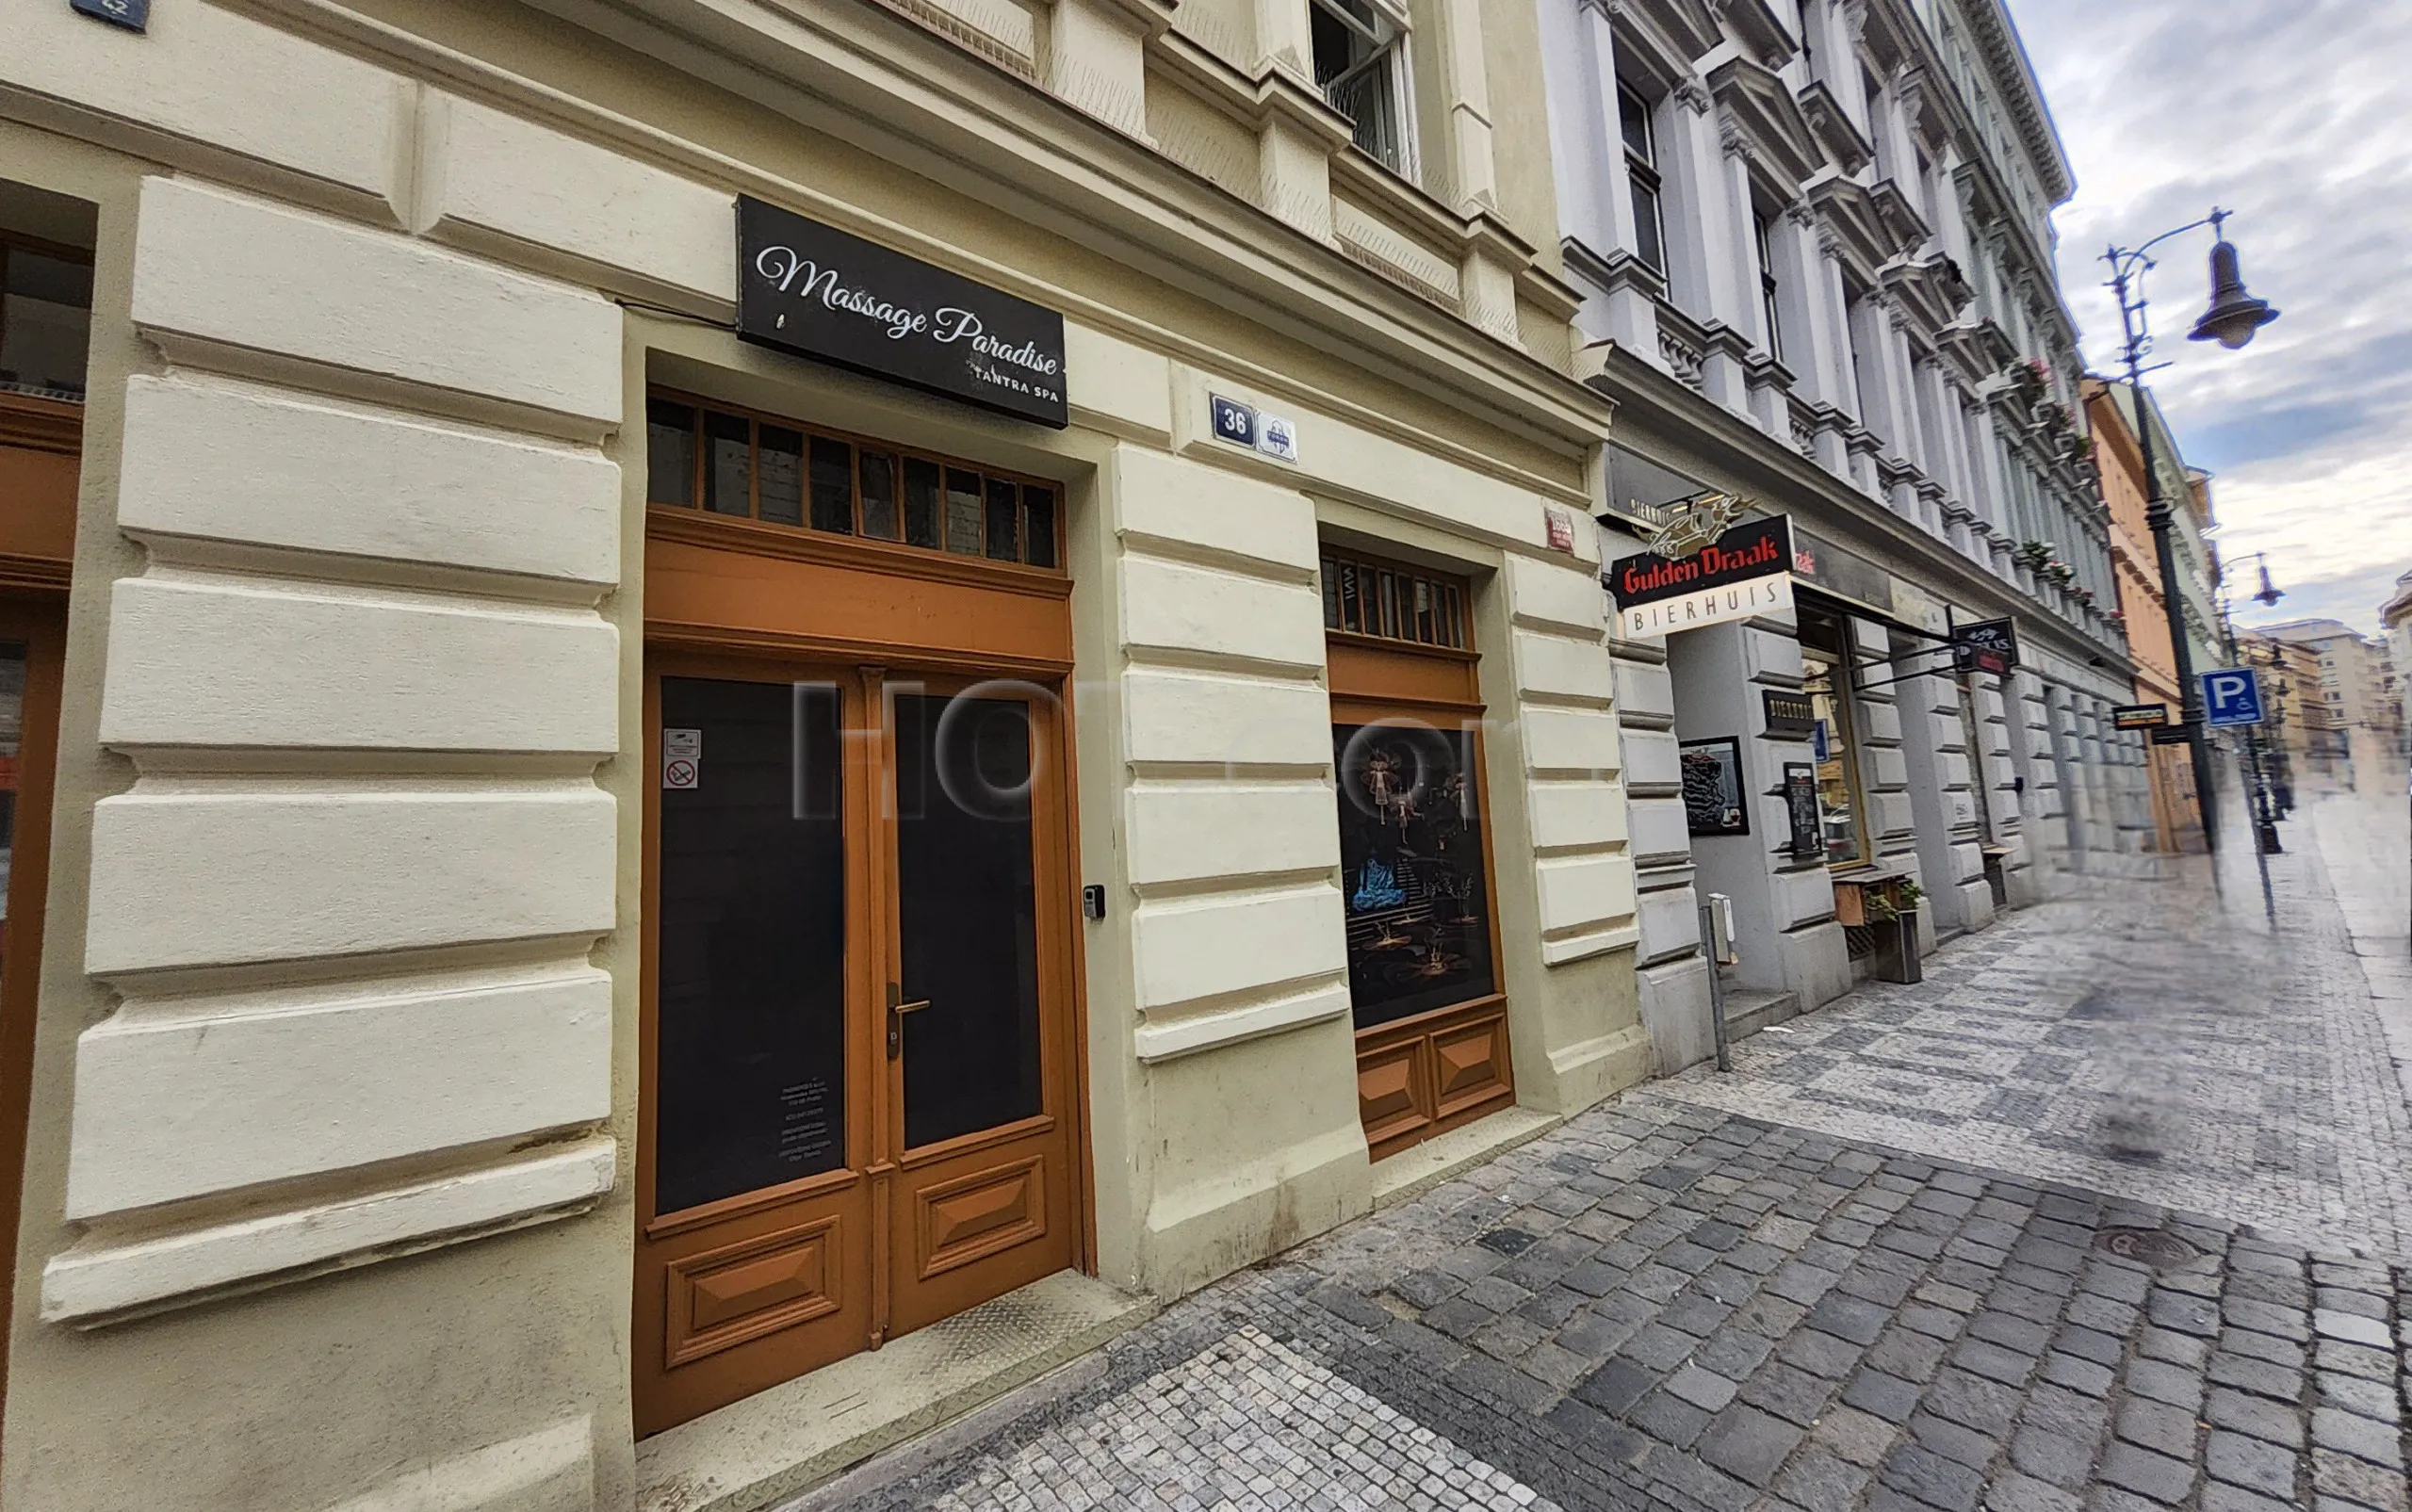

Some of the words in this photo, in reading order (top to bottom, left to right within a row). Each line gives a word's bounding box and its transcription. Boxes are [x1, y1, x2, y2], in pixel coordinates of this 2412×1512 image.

[757, 246, 927, 339] Massage
[933, 307, 1057, 375] Paradise
[974, 369, 1029, 394] TANTRA
[1035, 386, 1059, 403] SPA
[1224, 408, 1247, 434] 36
[1624, 561, 1699, 594] Gulden
[1701, 536, 1779, 575] Draak
[1634, 582, 1777, 630] BIERHUIS
[2211, 676, 2246, 708] P
